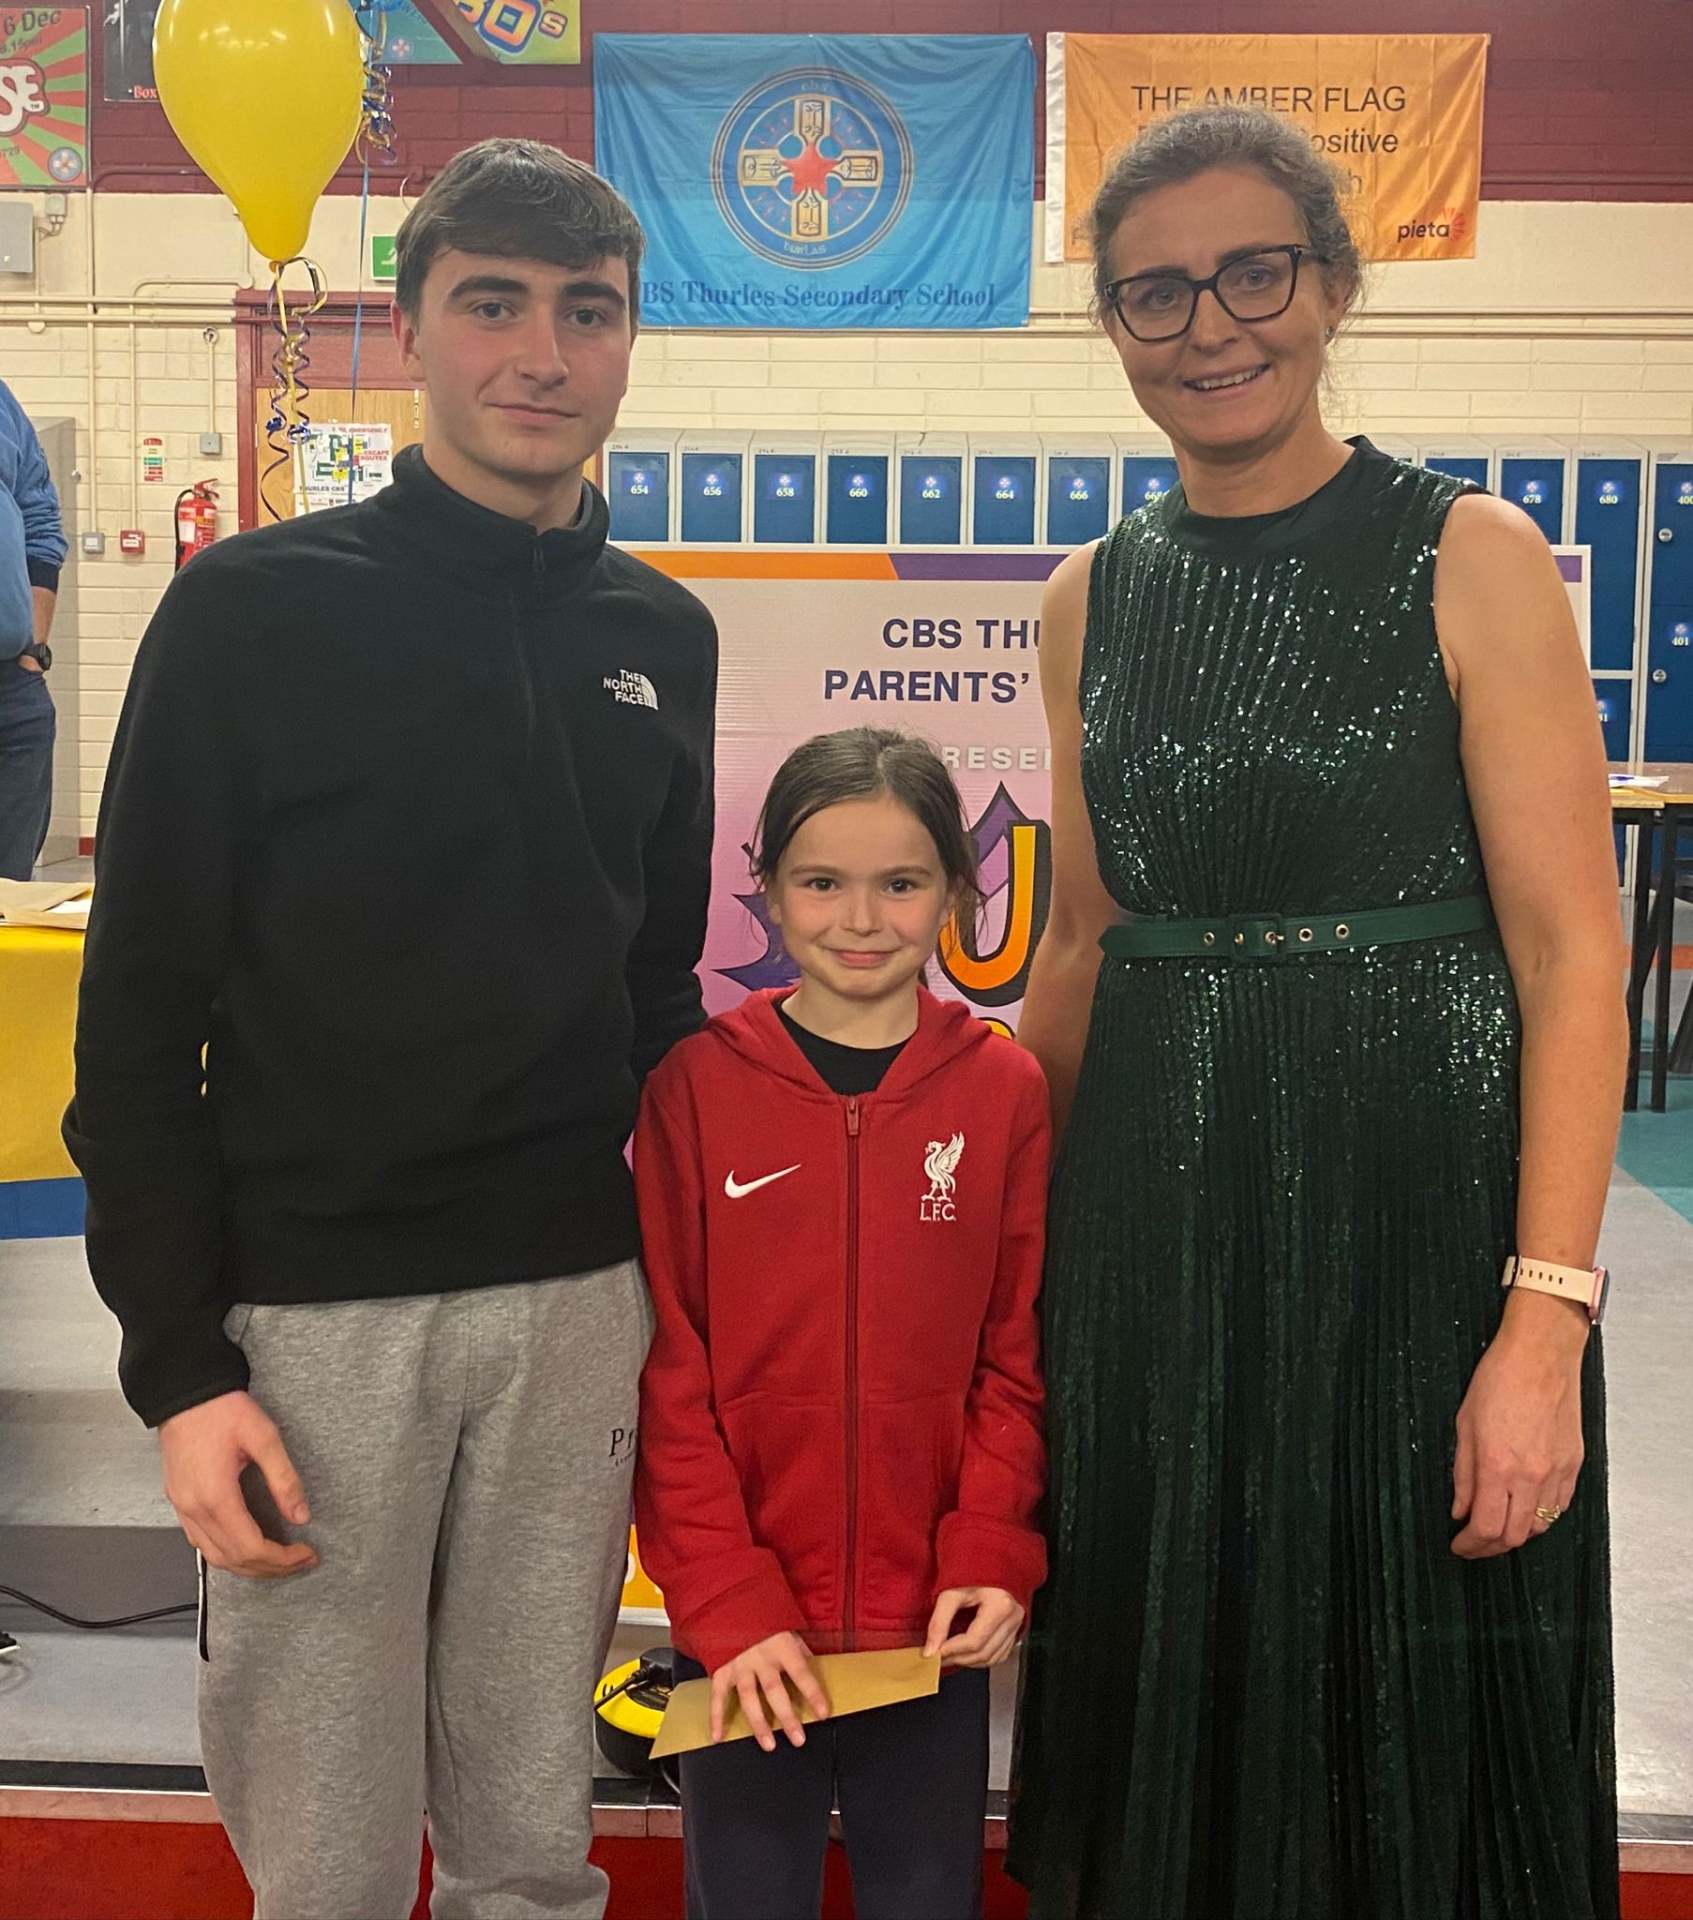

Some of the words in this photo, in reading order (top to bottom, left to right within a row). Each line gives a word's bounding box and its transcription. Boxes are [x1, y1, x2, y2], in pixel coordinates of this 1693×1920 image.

[22, 10, 62, 31] Dec
[1324, 86, 1406, 112] FLAG
[1307, 128, 1399, 154] ositive
[1397, 219, 1450, 244] pieta
[642, 282, 676, 304] BS
[682, 281, 775, 307] Thurles
[783, 285, 910, 311] Secondary
[917, 284, 996, 307] School
[630, 485, 649, 495] 654
[703, 486, 722, 496] 656
[776, 487, 795, 498] 658
[849, 488, 868, 498] 660
[922, 489, 941, 499] 662
[995, 490, 1015, 500] 664
[1069, 490, 1089, 500] 666
[1522, 494, 1542, 504] 678
[1599, 495, 1618, 505] 680
[882, 618, 962, 649] CBS
[1671, 637, 1689, 646] 401
[620, 669, 640, 684] THE
[603, 677, 643, 694] NORTH
[615, 691, 645, 705] FACE
[941, 746, 1051, 771] RESE
